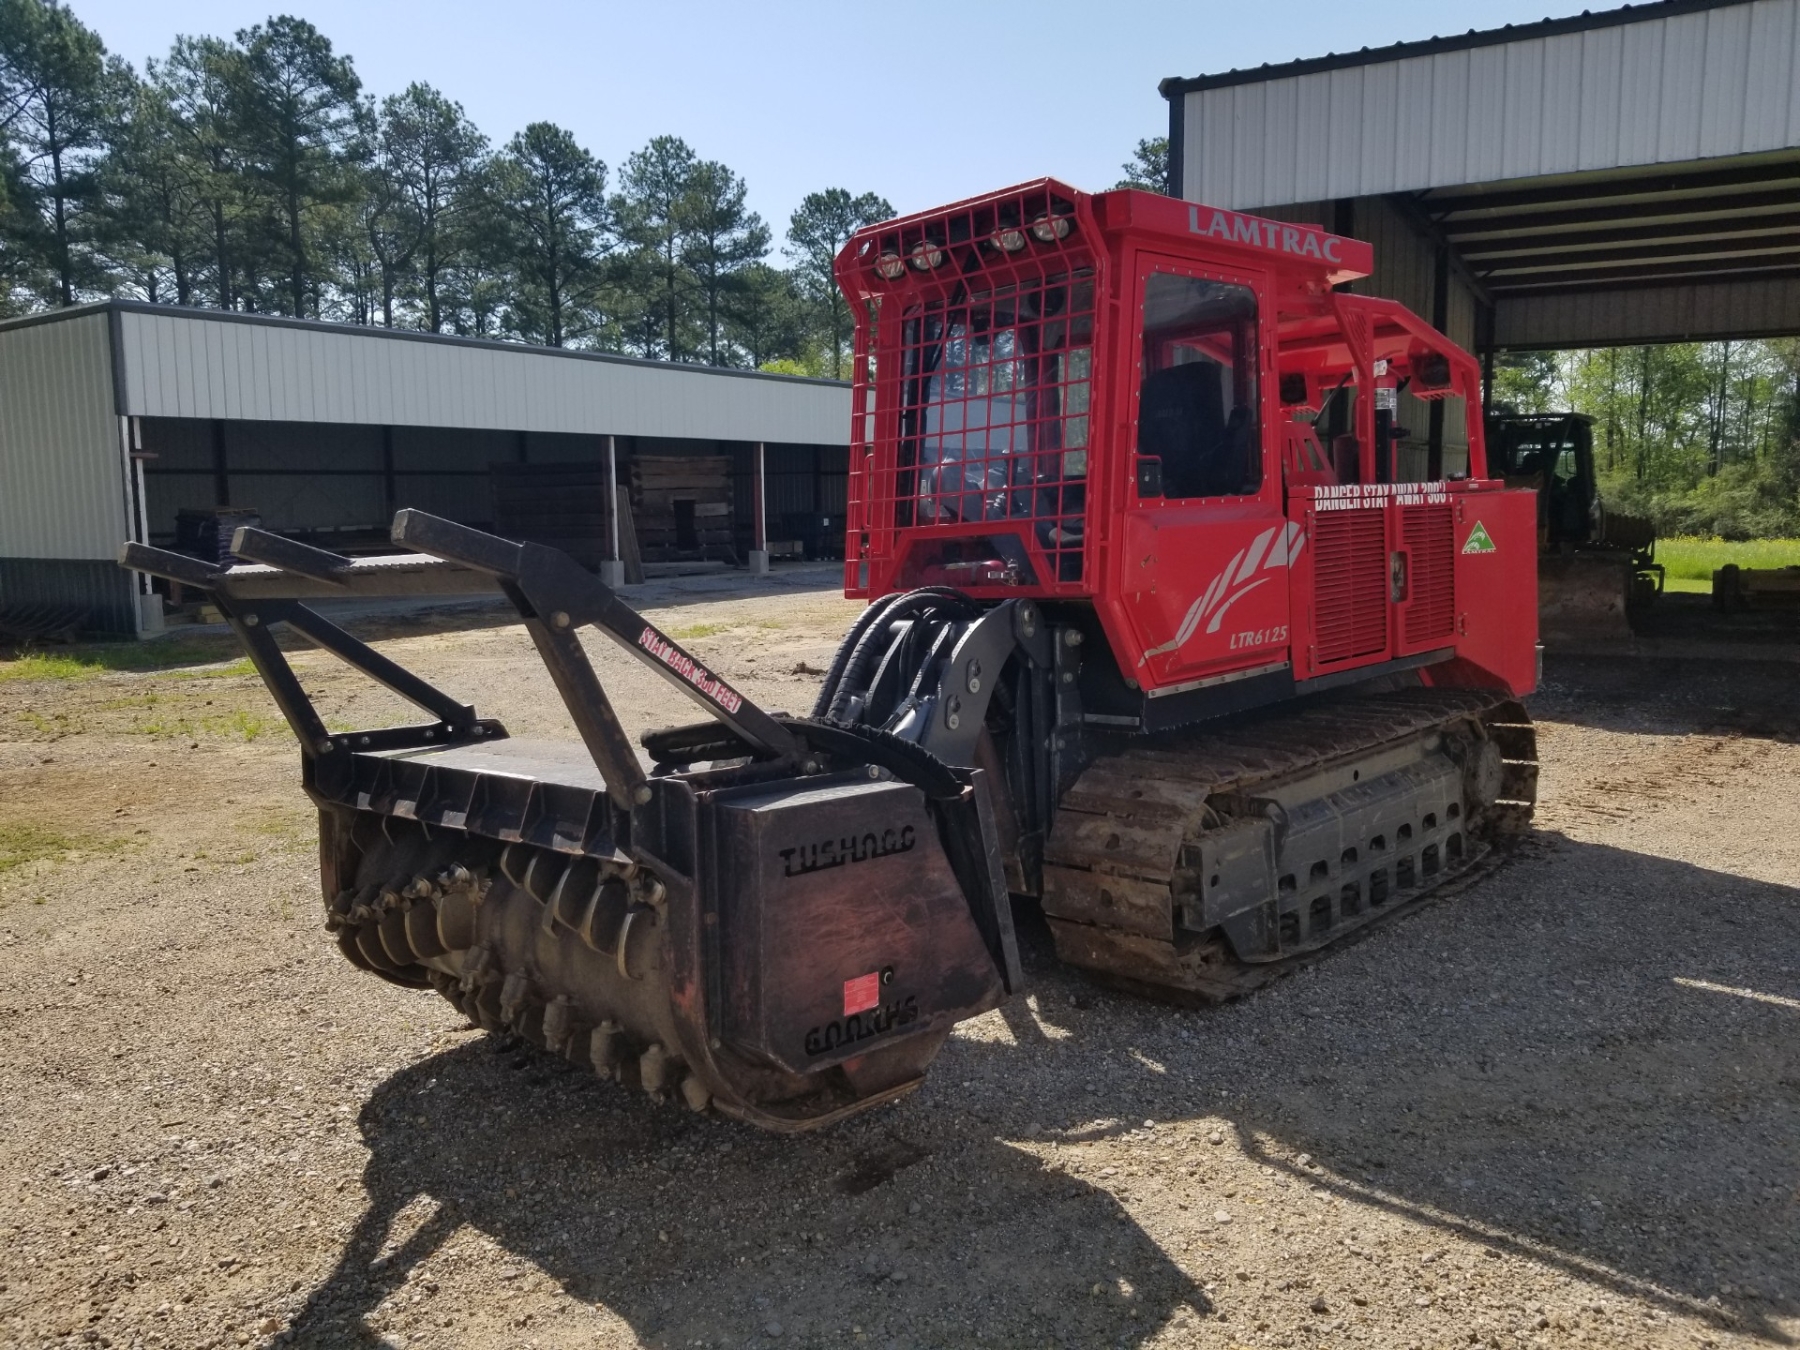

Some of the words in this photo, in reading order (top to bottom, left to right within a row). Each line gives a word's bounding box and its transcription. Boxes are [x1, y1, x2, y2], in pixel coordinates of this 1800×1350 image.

[1188, 205, 1342, 264] LAMTRAC
[1314, 484, 1361, 512] DANGER
[1363, 483, 1389, 508] STAY
[1391, 482, 1424, 506] AWAY
[1229, 624, 1288, 650] LTR6125
[640, 627, 667, 658] STAY
[666, 650, 697, 680] BACK
[714, 684, 742, 712] FEET
